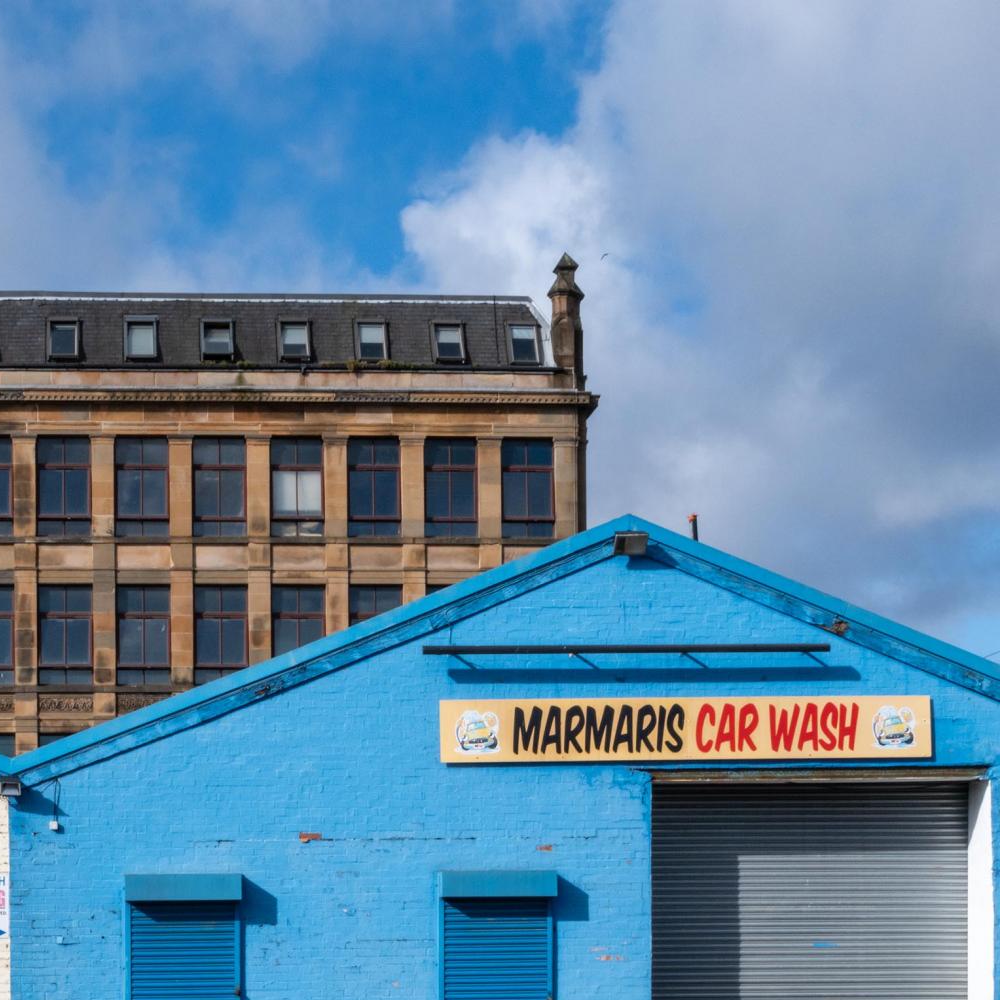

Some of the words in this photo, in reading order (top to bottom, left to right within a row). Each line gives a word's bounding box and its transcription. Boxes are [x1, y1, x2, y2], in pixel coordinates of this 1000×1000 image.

[512, 703, 685, 755] MARMARIS
[695, 702, 759, 753] CAR
[769, 702, 860, 752] WASH
